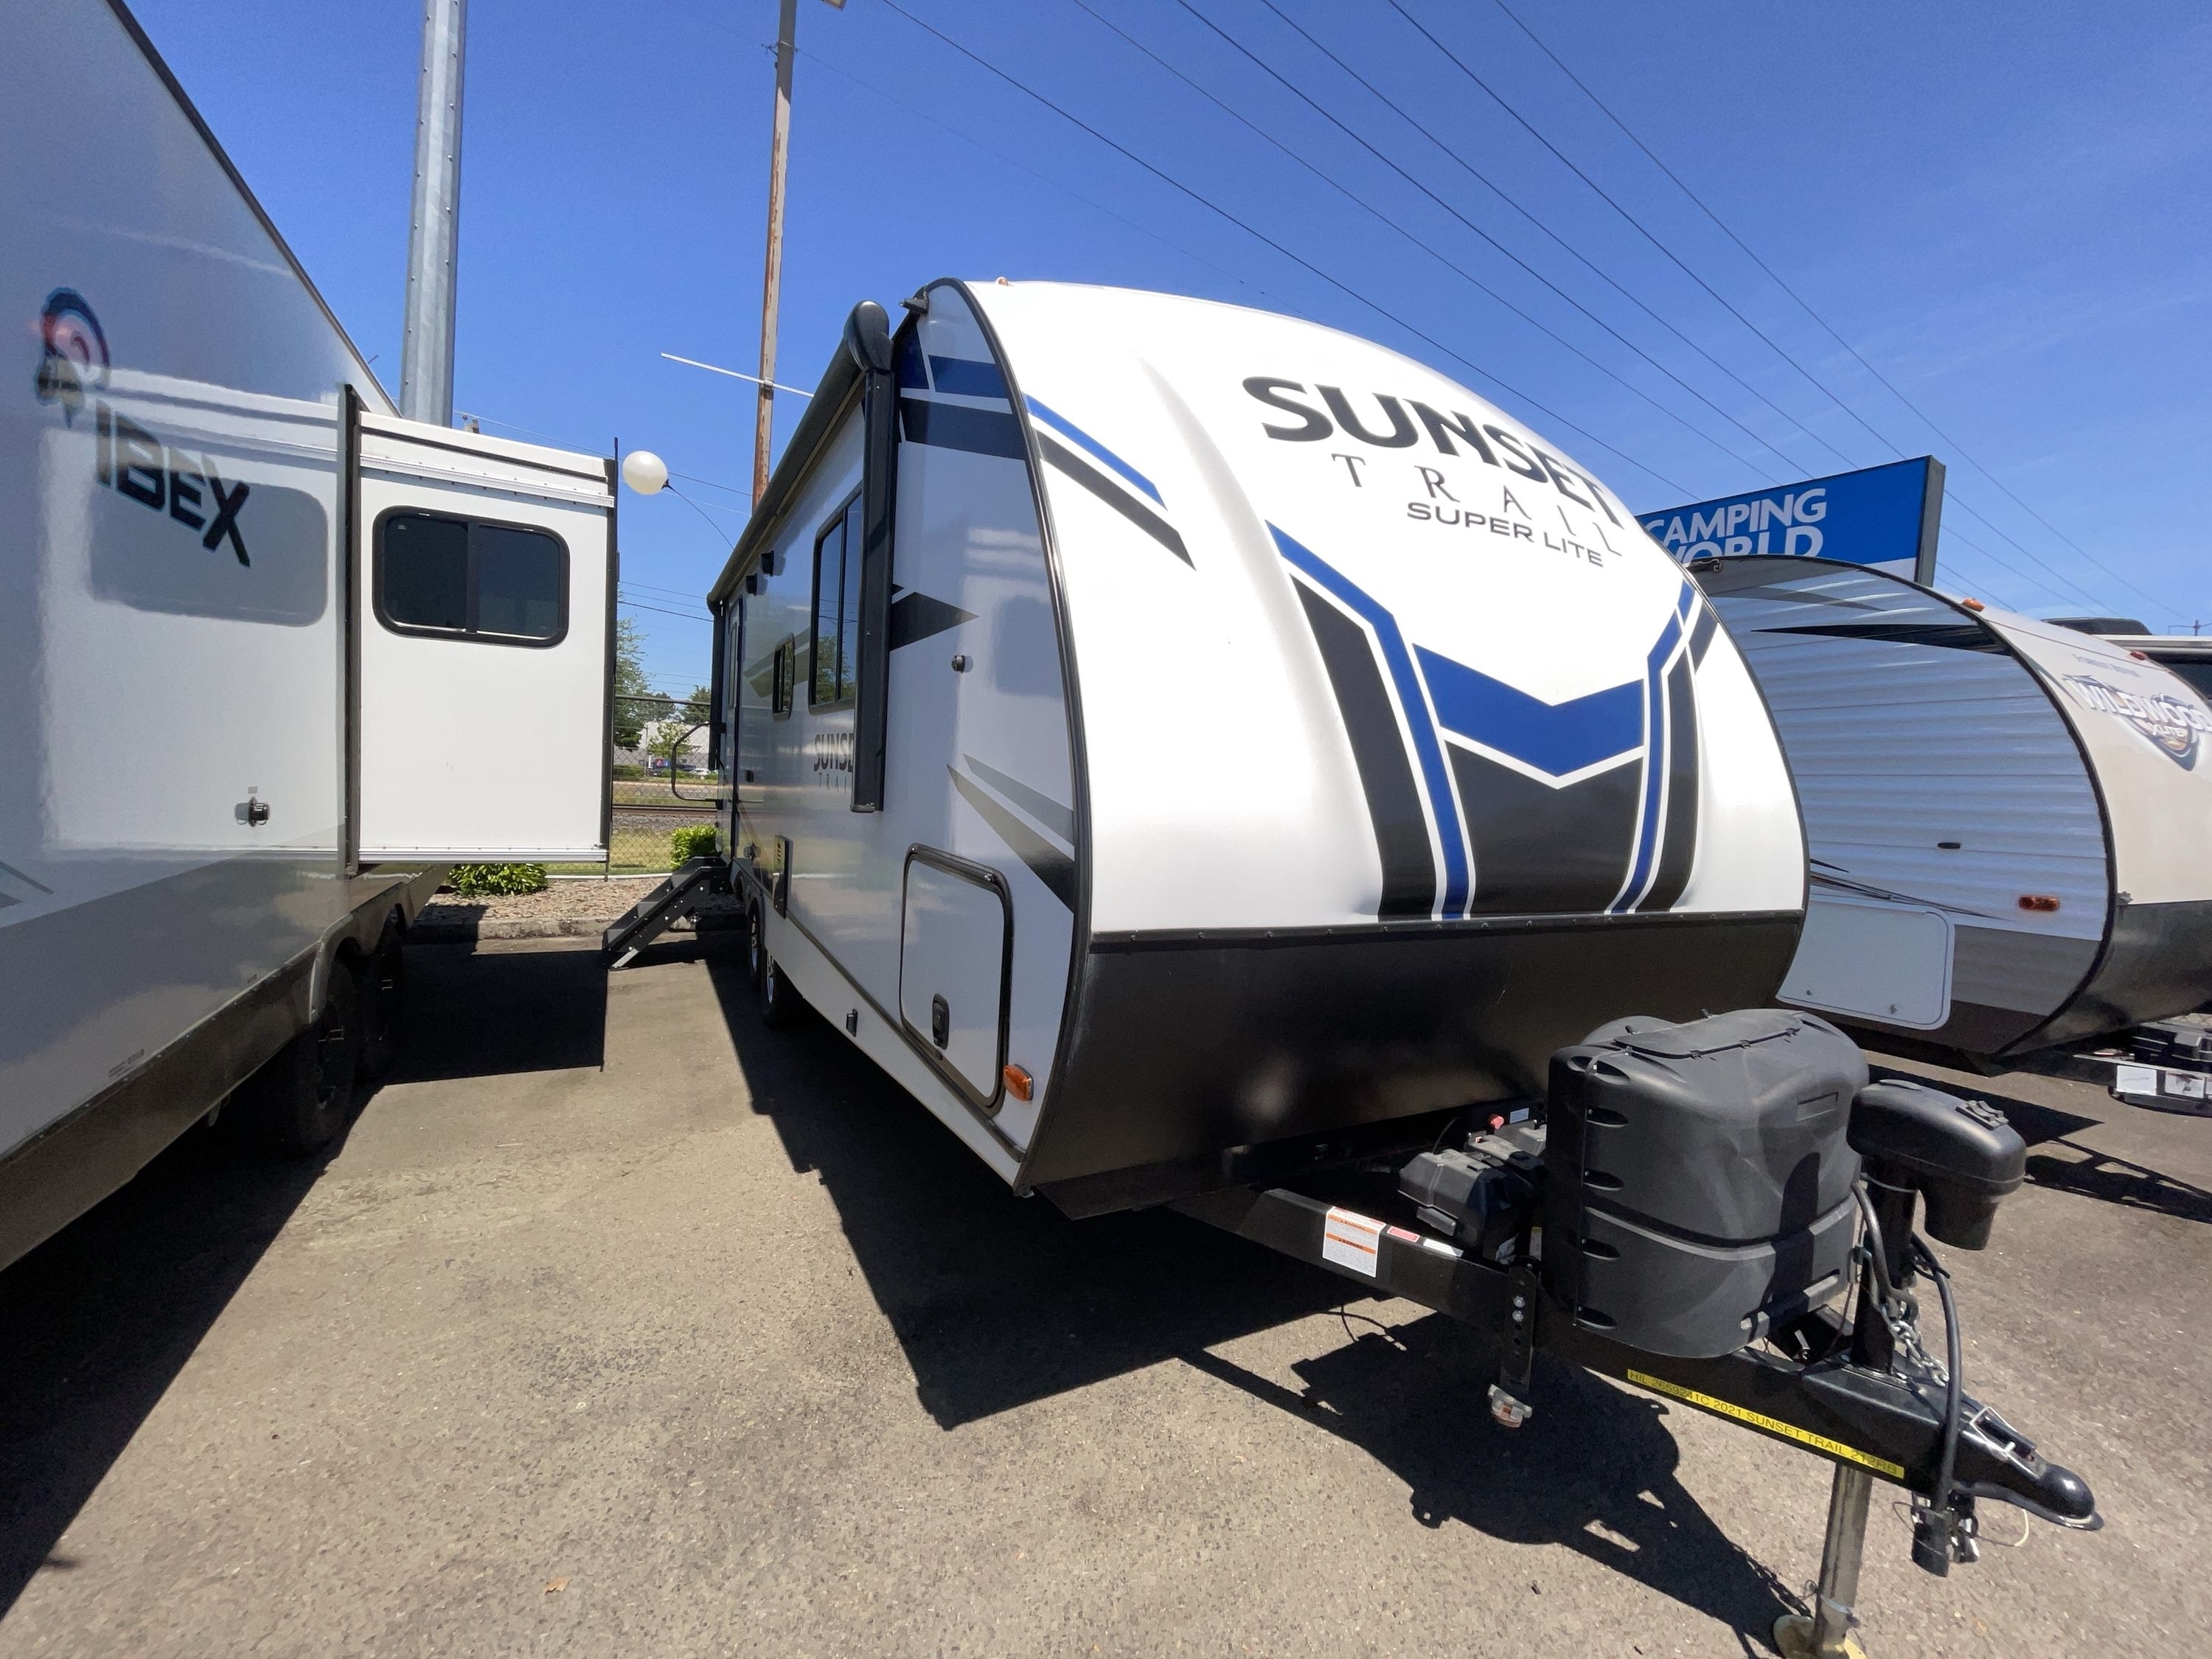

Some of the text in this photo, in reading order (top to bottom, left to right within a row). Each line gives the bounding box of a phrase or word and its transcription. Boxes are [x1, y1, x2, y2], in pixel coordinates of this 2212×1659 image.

[95, 399, 250, 568] IBEX
[1242, 375, 1624, 529] SUNSET
[1330, 452, 1622, 557] TRAIL
[1407, 501, 1604, 568] SUPER LITE
[813, 732, 854, 773] SUNSE
[818, 772, 847, 795] TRAI
[1630, 1371, 1646, 1384] HIL
[1714, 1399, 1742, 1416] 2021
[1746, 1412, 1802, 1438] SUNSET
[1806, 1433, 1846, 1456] TRAIL
